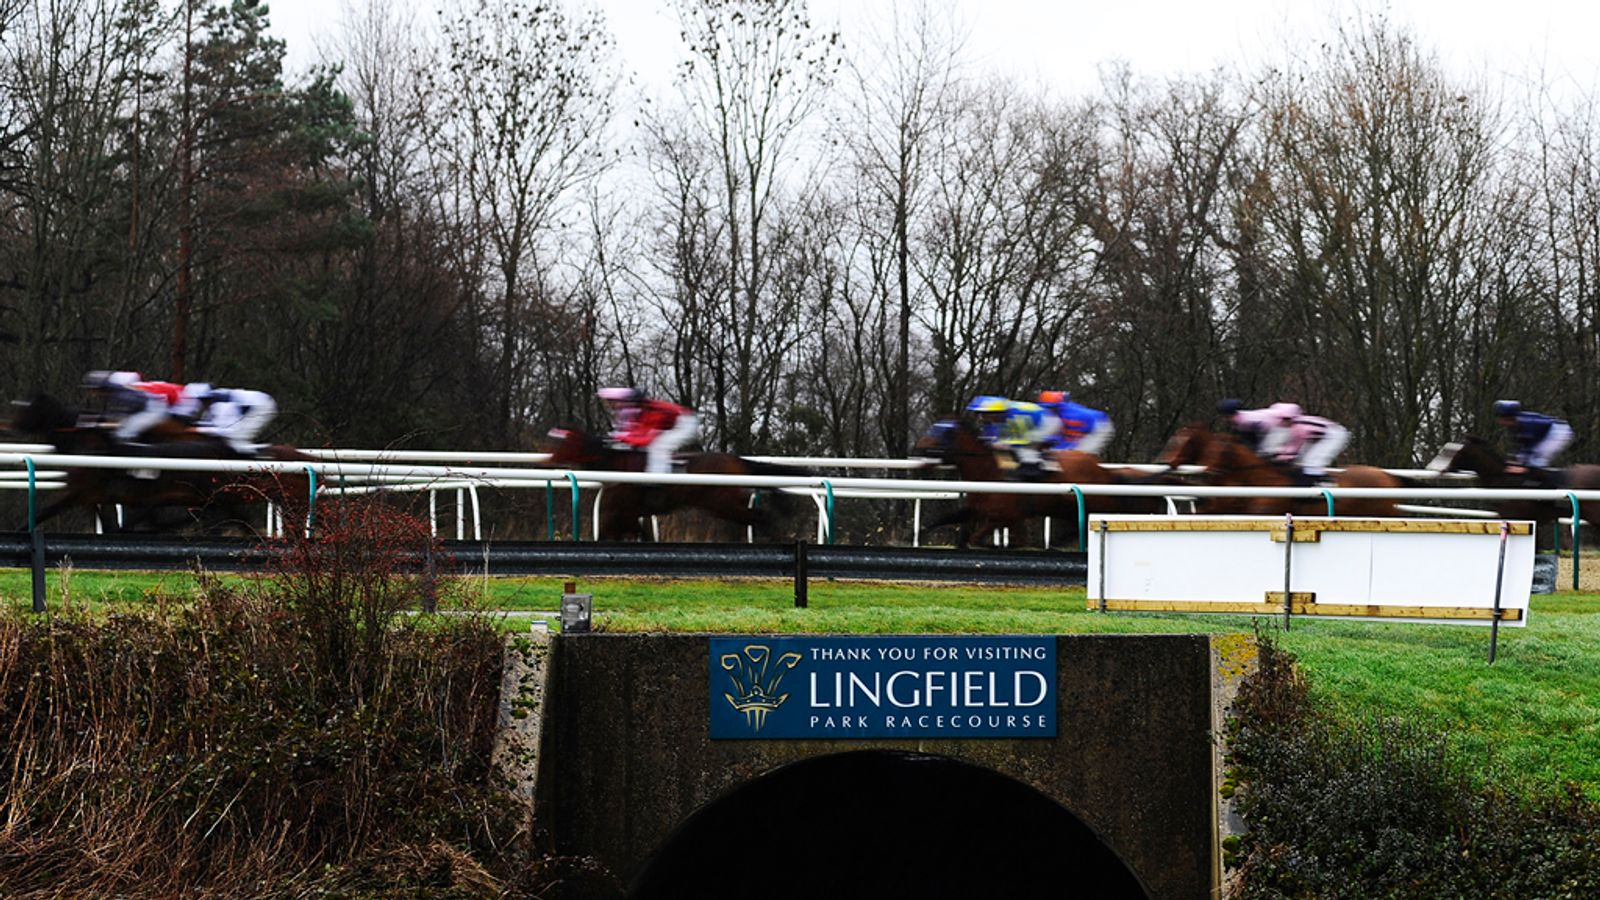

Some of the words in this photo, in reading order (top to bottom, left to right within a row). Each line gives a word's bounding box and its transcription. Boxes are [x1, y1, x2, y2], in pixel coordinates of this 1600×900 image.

[810, 647, 871, 660] THANK
[878, 647, 916, 660] YOU
[923, 647, 958, 660] FOR
[965, 647, 1047, 660] VISITING
[809, 670, 1048, 708] LINGFIELD
[810, 715, 868, 728] PARK
[886, 715, 1047, 728] RACECOURSE
